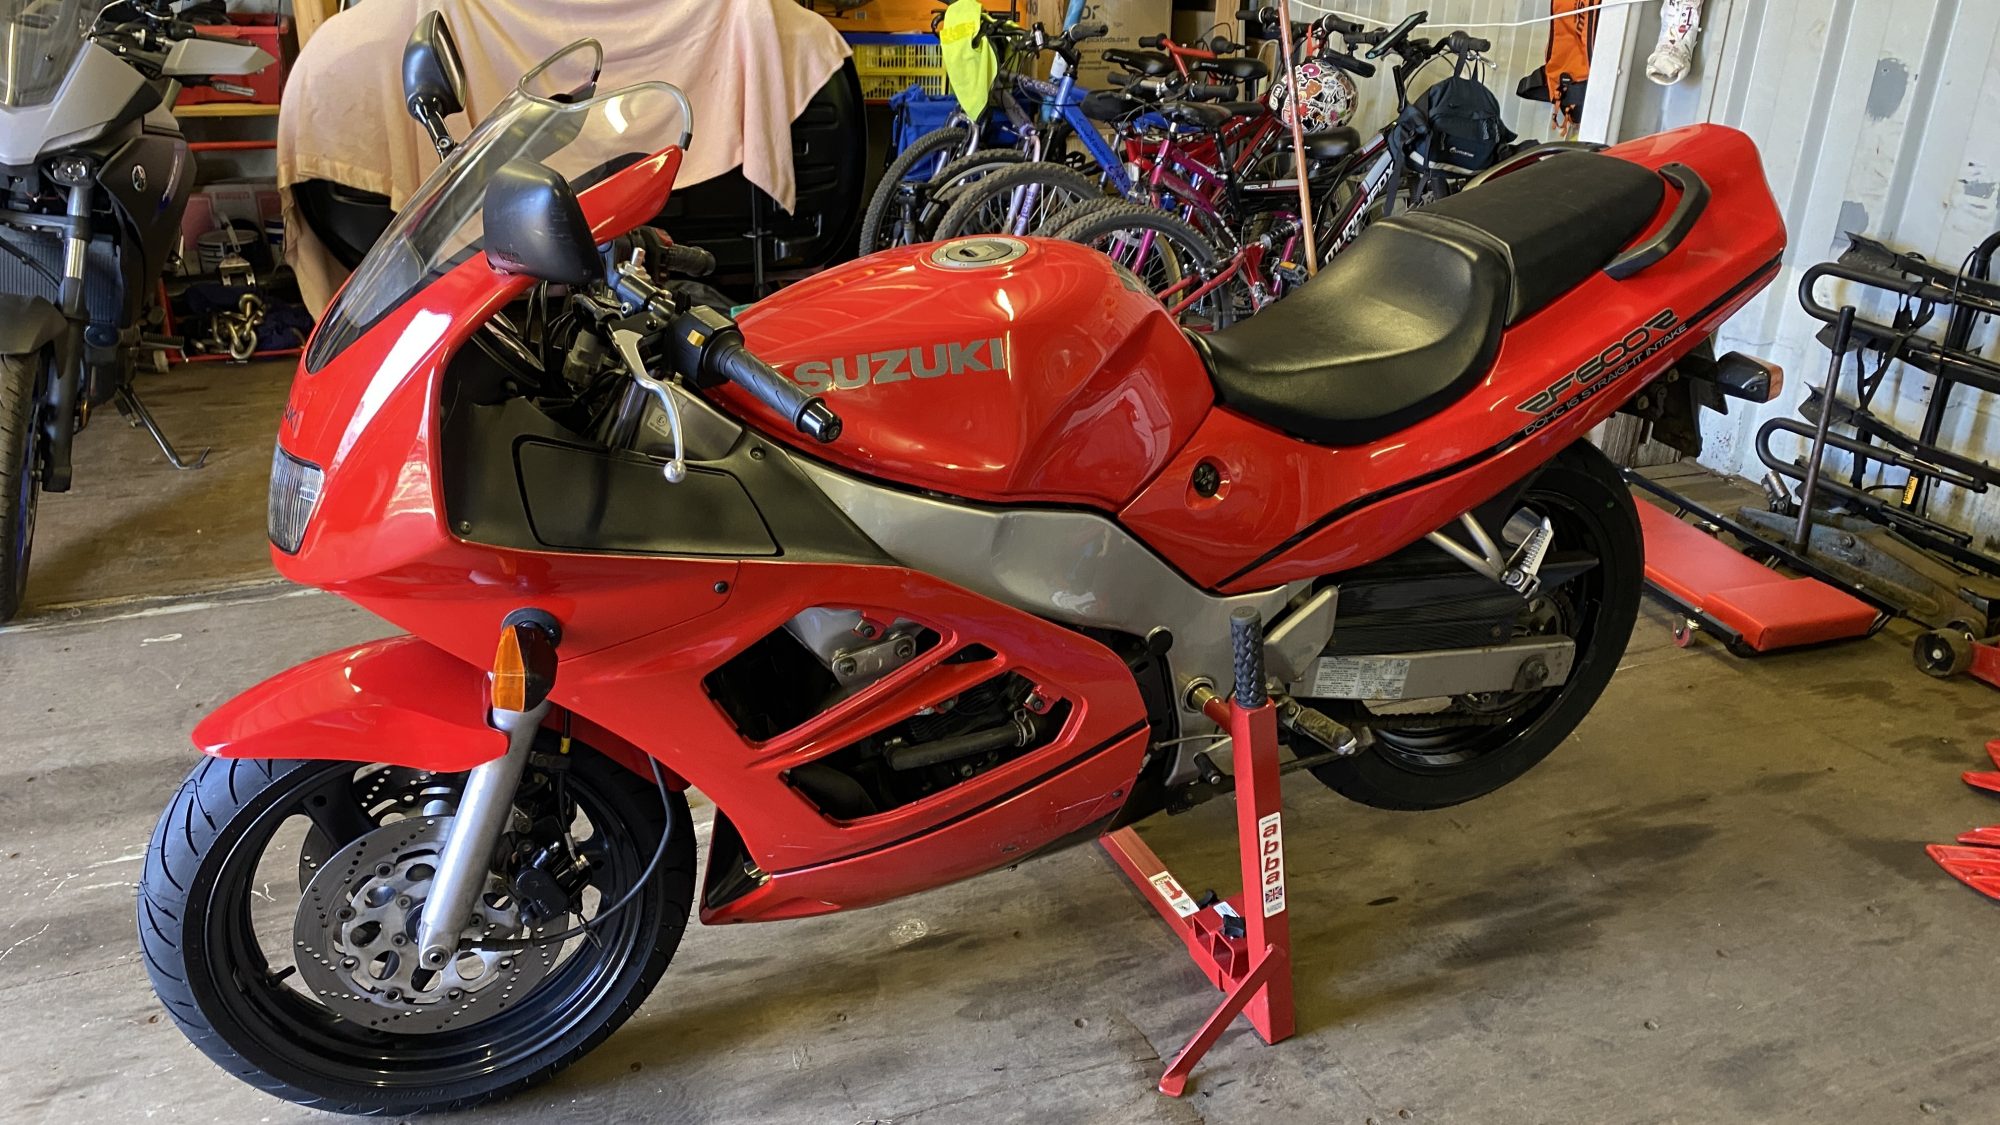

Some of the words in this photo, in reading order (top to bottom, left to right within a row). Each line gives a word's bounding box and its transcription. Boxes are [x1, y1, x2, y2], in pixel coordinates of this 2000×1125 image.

[793, 337, 1006, 395] SUZUKI
[1515, 308, 1678, 415] RF600R
[1524, 401, 1566, 436] DOHC
[1581, 355, 1643, 401] STRAIGHT
[1645, 322, 1688, 357] INTAKE
[1263, 823, 1280, 885] abba
